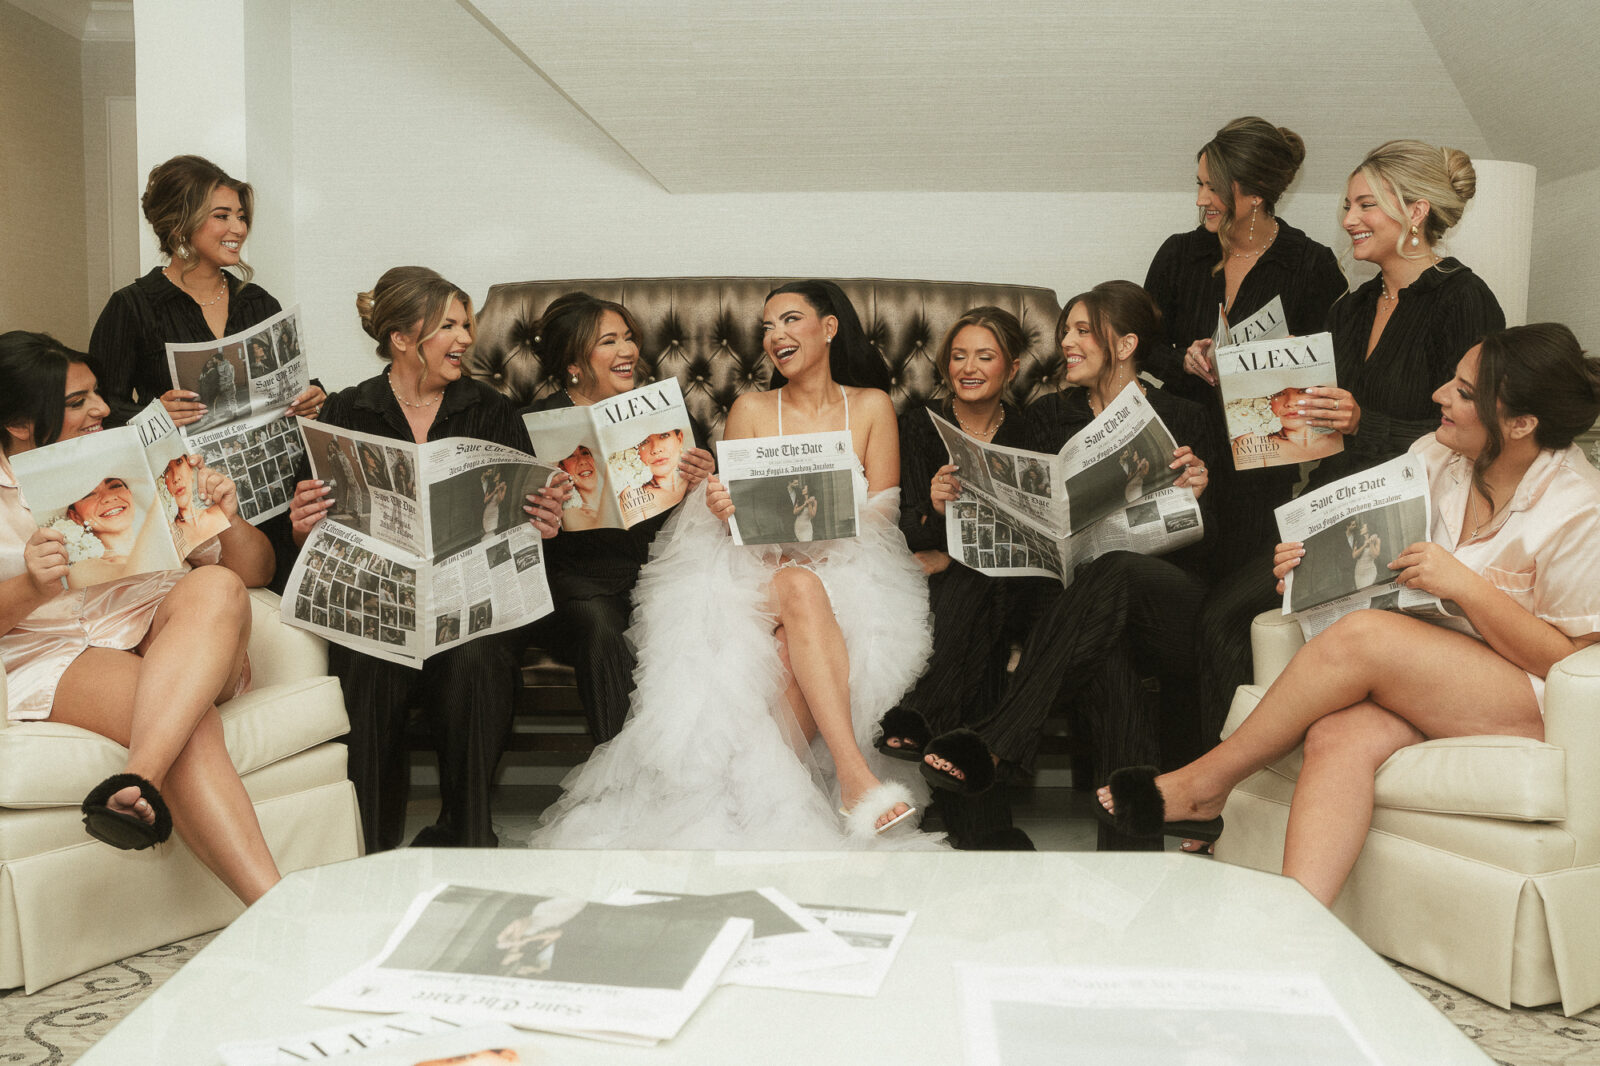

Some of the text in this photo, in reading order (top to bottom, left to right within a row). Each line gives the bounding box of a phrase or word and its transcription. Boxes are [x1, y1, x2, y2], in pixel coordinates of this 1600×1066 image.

[1232, 311, 1276, 347] LEXA
[1235, 345, 1318, 374] ALEXA
[256, 378, 275, 389] Save
[605, 389, 671, 427] ALEXA
[198, 430, 224, 445] Lifetime
[224, 426, 230, 437] of
[1084, 406, 1131, 449] Save The Date
[456, 443, 482, 455] Save
[484, 444, 506, 453] The
[1235, 435, 1275, 447] YOU'RE
[1236, 443, 1280, 455] INVITED
[756, 446, 779, 458] Save
[781, 444, 800, 457] The
[801, 443, 823, 455] Date
[462, 460, 480, 471] Foggia
[766, 468, 784, 477] Foggia
[790, 465, 812, 473] Anthony
[622, 493, 655, 512] INVITED
[1310, 494, 1333, 512] Save
[1335, 485, 1357, 500] The
[1359, 477, 1386, 493] Date
[1322, 514, 1340, 529] Foggia
[1346, 502, 1372, 516] Anthony
[326, 523, 346, 538] Lifetime
